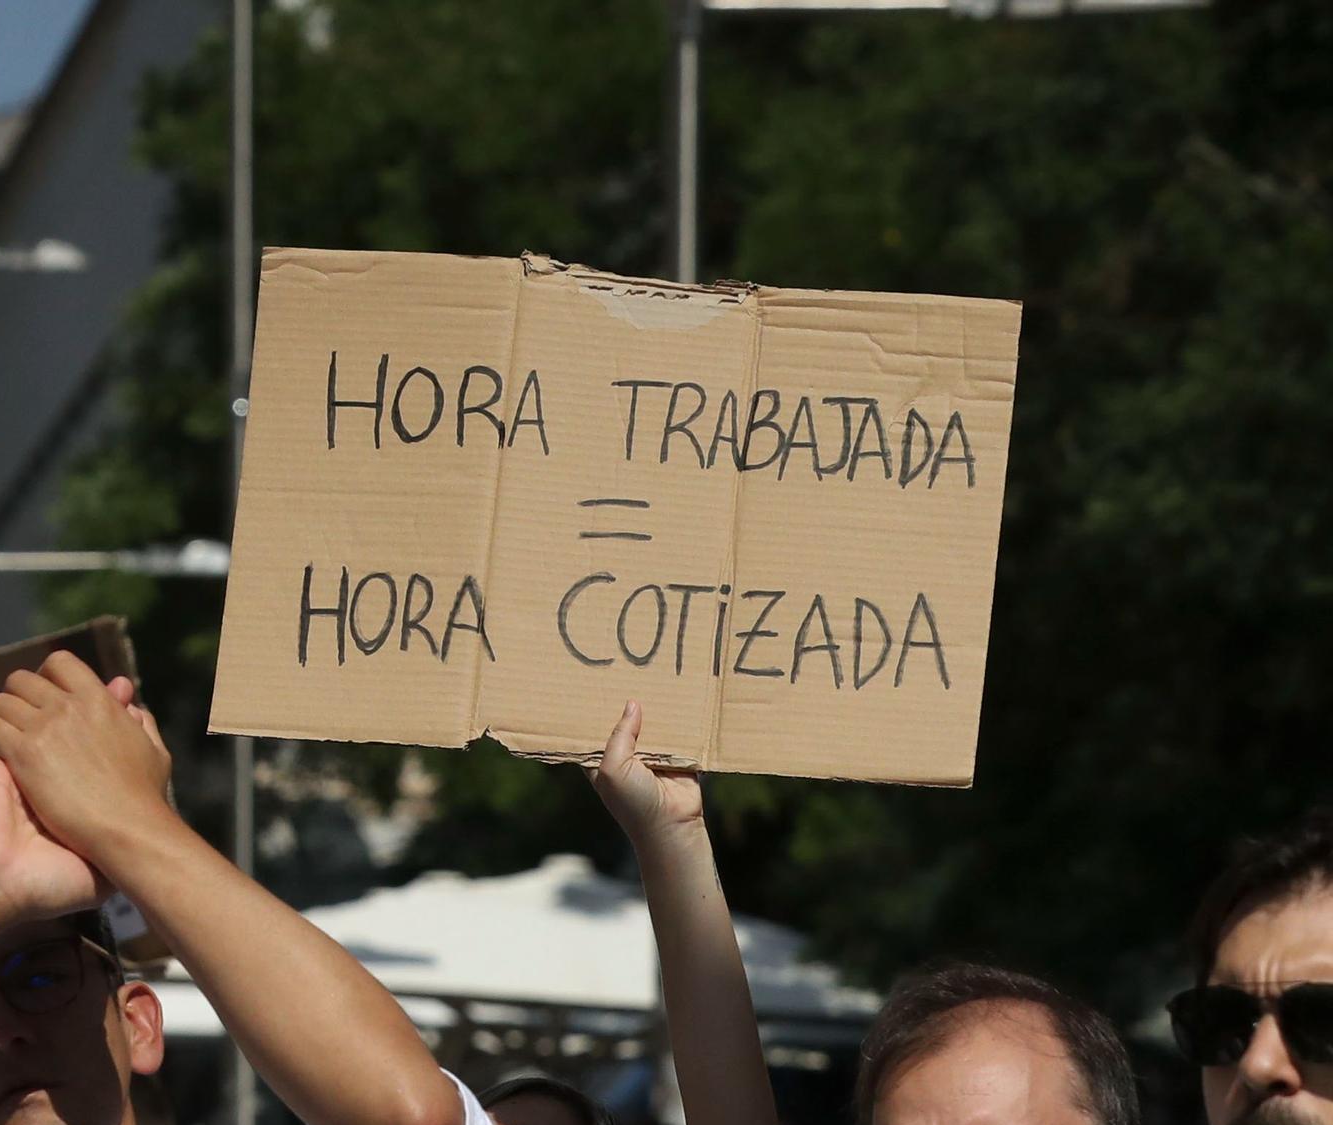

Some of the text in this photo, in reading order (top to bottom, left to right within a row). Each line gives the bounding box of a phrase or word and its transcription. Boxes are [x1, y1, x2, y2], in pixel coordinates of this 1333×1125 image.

[327, 351, 976, 489] HORA TRABAJADA
[298, 561, 495, 667] HORA
